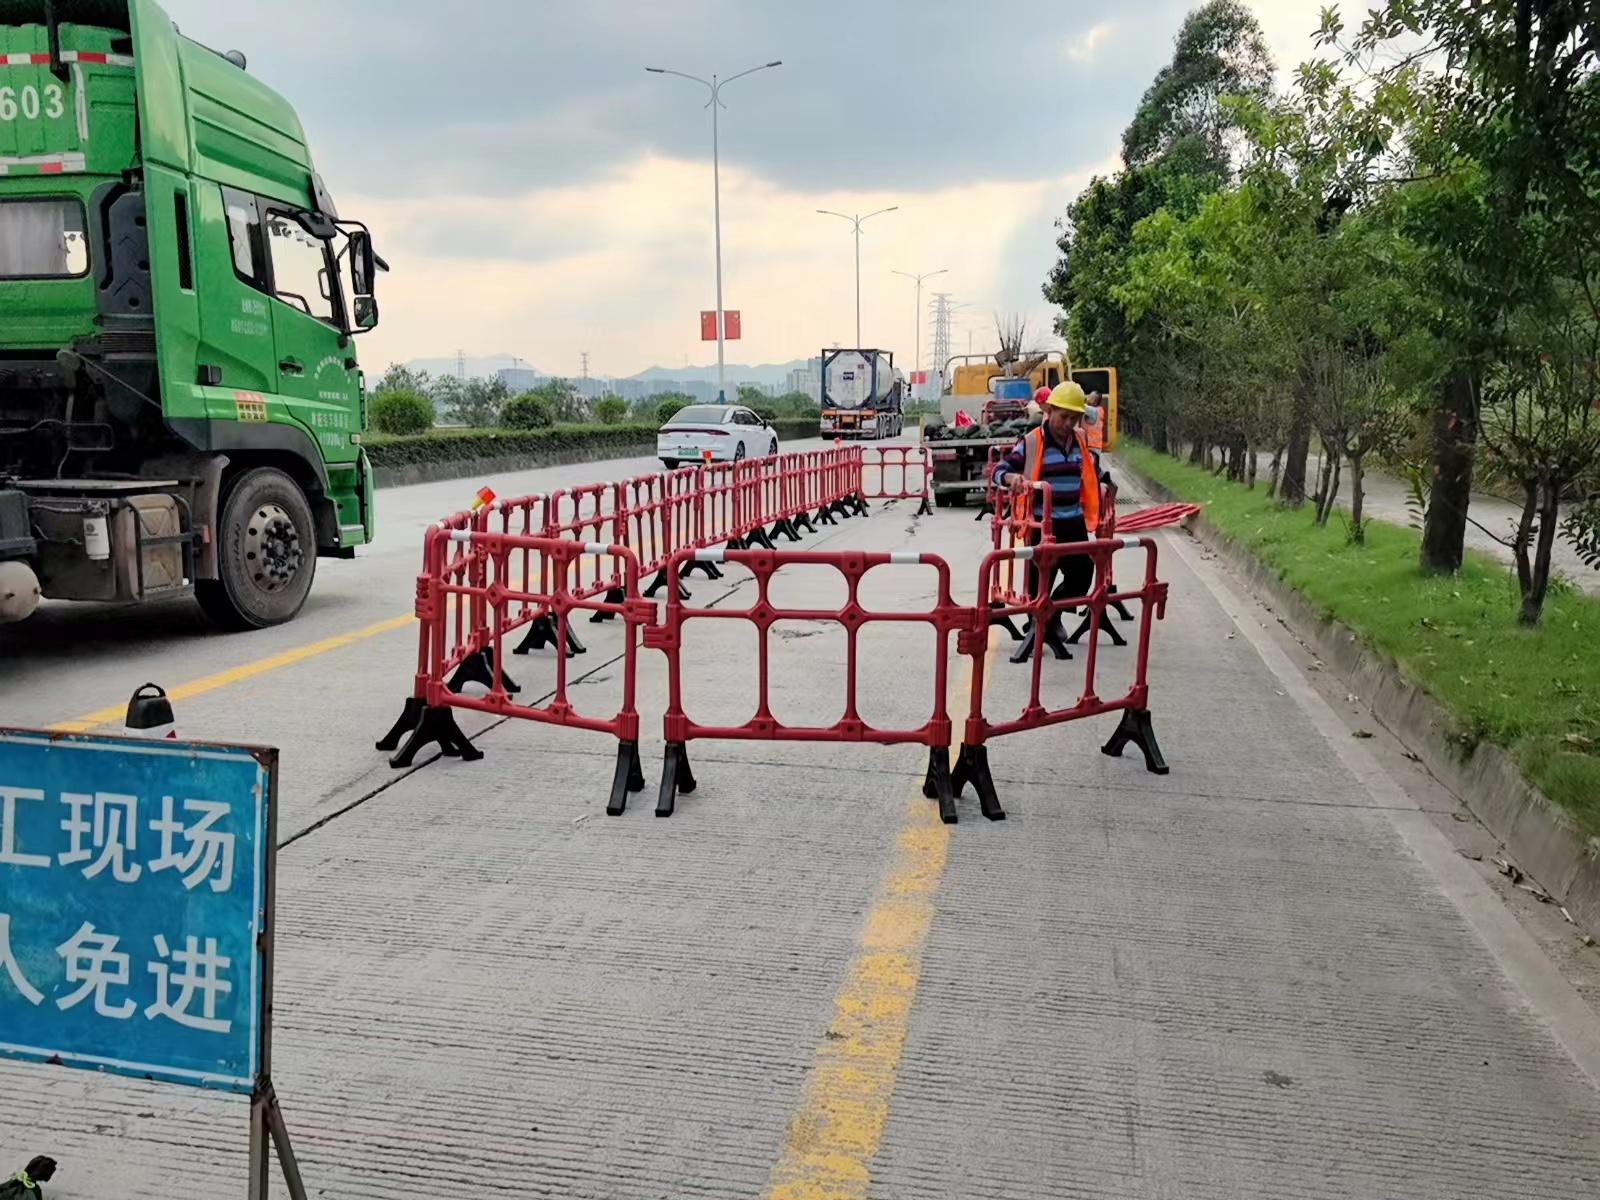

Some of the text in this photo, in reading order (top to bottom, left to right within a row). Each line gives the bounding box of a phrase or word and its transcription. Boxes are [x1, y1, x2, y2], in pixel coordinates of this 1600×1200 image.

[0, 84, 64, 120] 603
[0, 786, 236, 893] 工现场
